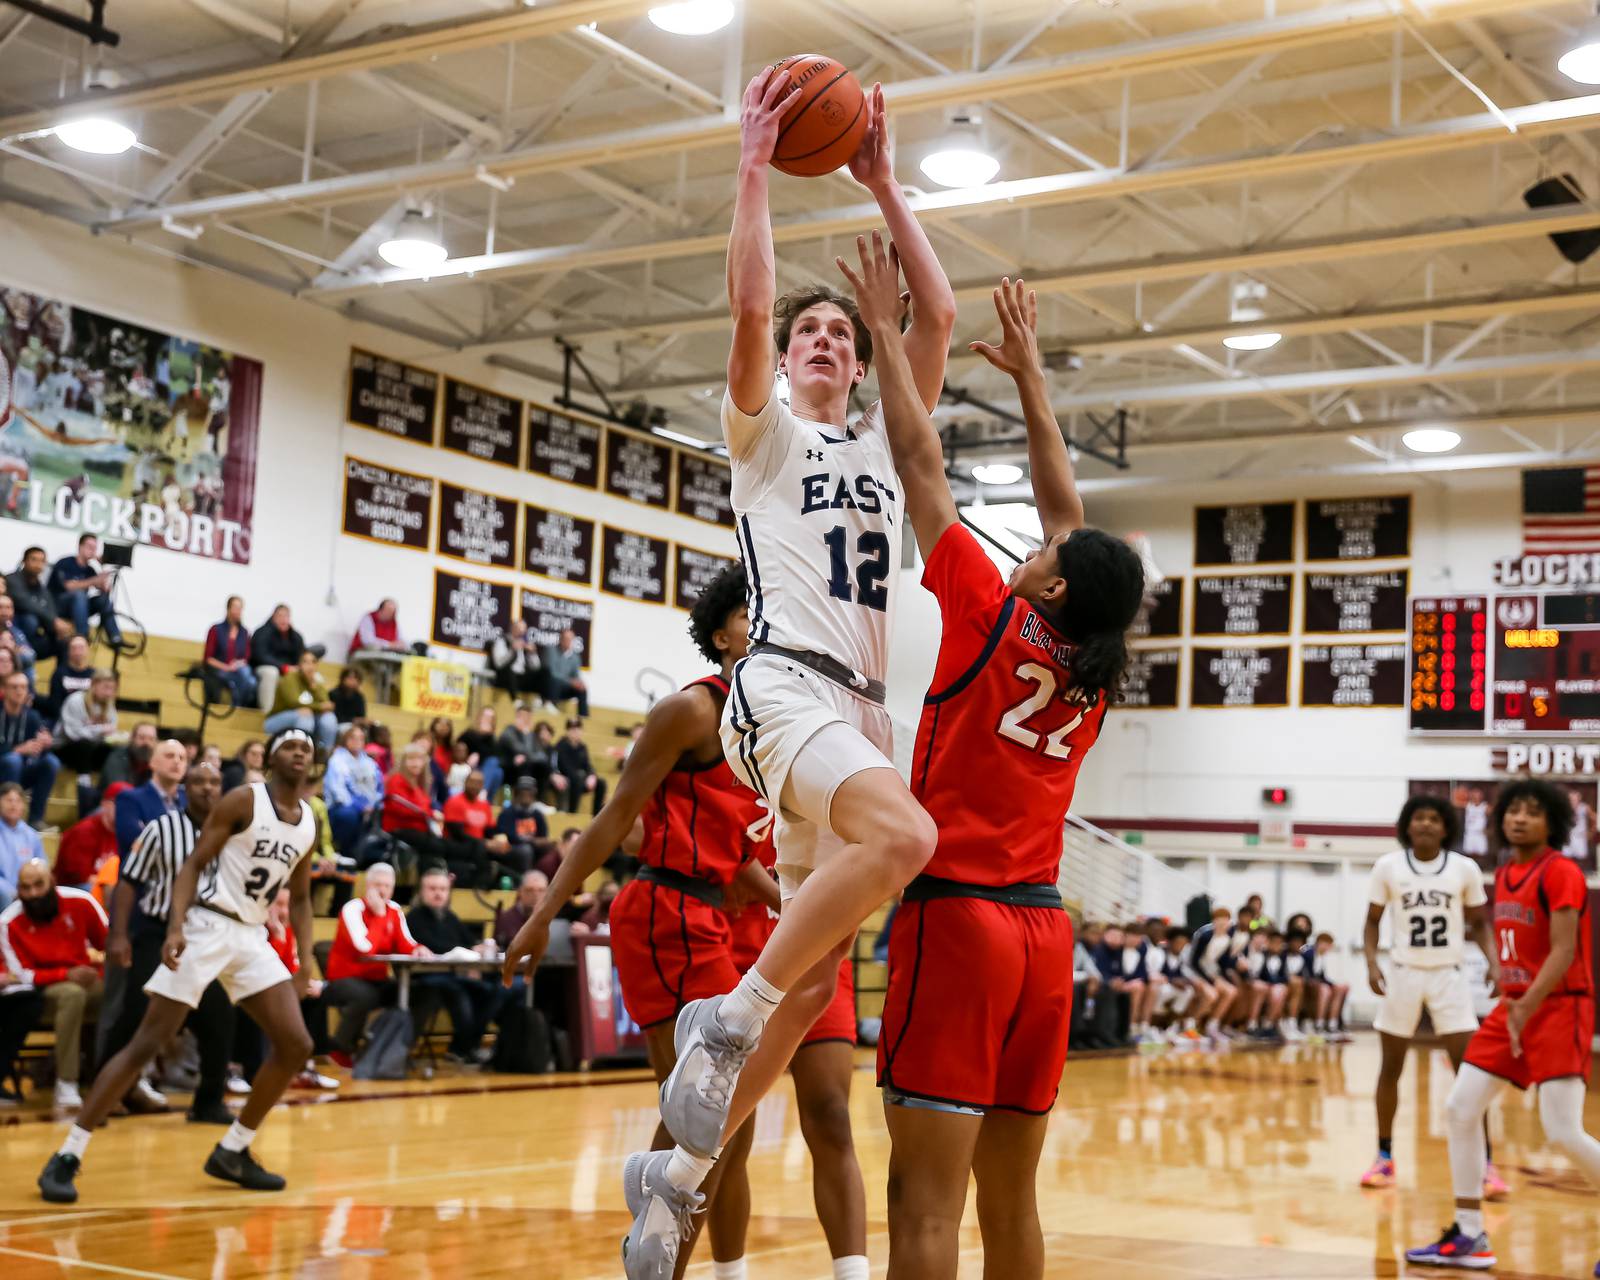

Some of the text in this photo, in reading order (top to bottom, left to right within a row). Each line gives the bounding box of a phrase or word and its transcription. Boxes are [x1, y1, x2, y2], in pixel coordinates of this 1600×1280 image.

[360, 388, 426, 424] CHAMPIONS
[451, 416, 513, 448] CHAMPIONS
[535, 441, 592, 471] CHAMPIONS
[372, 484, 409, 508] STATE
[28, 478, 242, 561] LOCKPORT
[355, 498, 423, 531] CHAMPIONS
[824, 525, 890, 612] 12
[1222, 590, 1263, 605] STATE
[1333, 587, 1377, 603] STATE
[1331, 659, 1378, 676] STATE
[1506, 743, 1600, 774] PORT
[1402, 889, 1454, 911] EAST
[1409, 915, 1448, 948] 22
